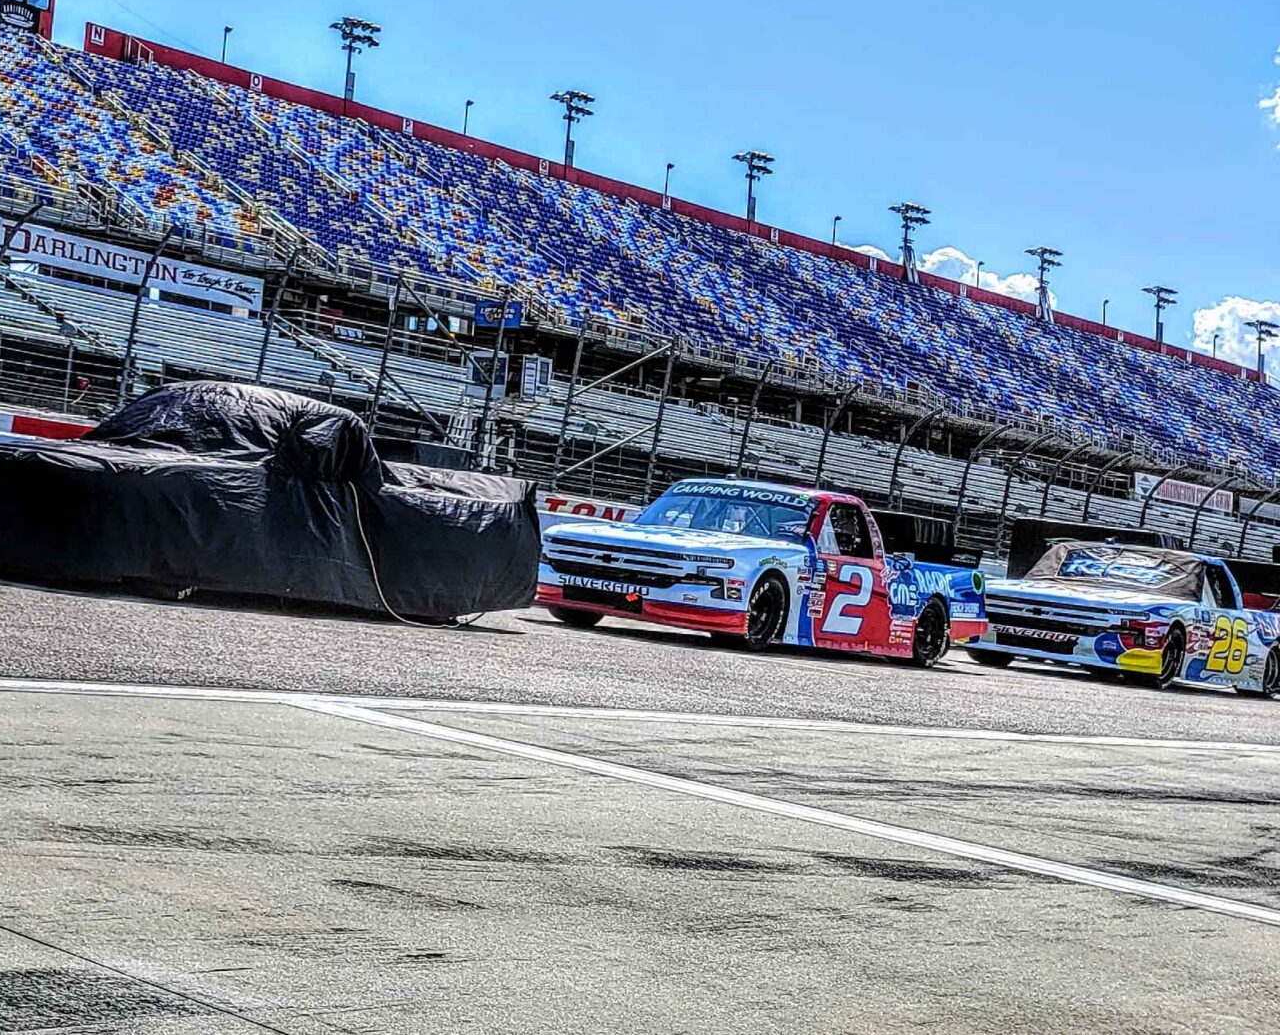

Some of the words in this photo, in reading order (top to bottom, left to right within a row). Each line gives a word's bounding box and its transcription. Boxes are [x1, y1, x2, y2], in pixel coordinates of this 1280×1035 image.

[94, 25, 103, 41] N
[4, 224, 178, 284] DARLINGTON
[672, 483, 740, 498] CAMPING
[741, 488, 807, 508] WORLD
[821, 563, 874, 635] 2
[1206, 615, 1249, 674] 26
